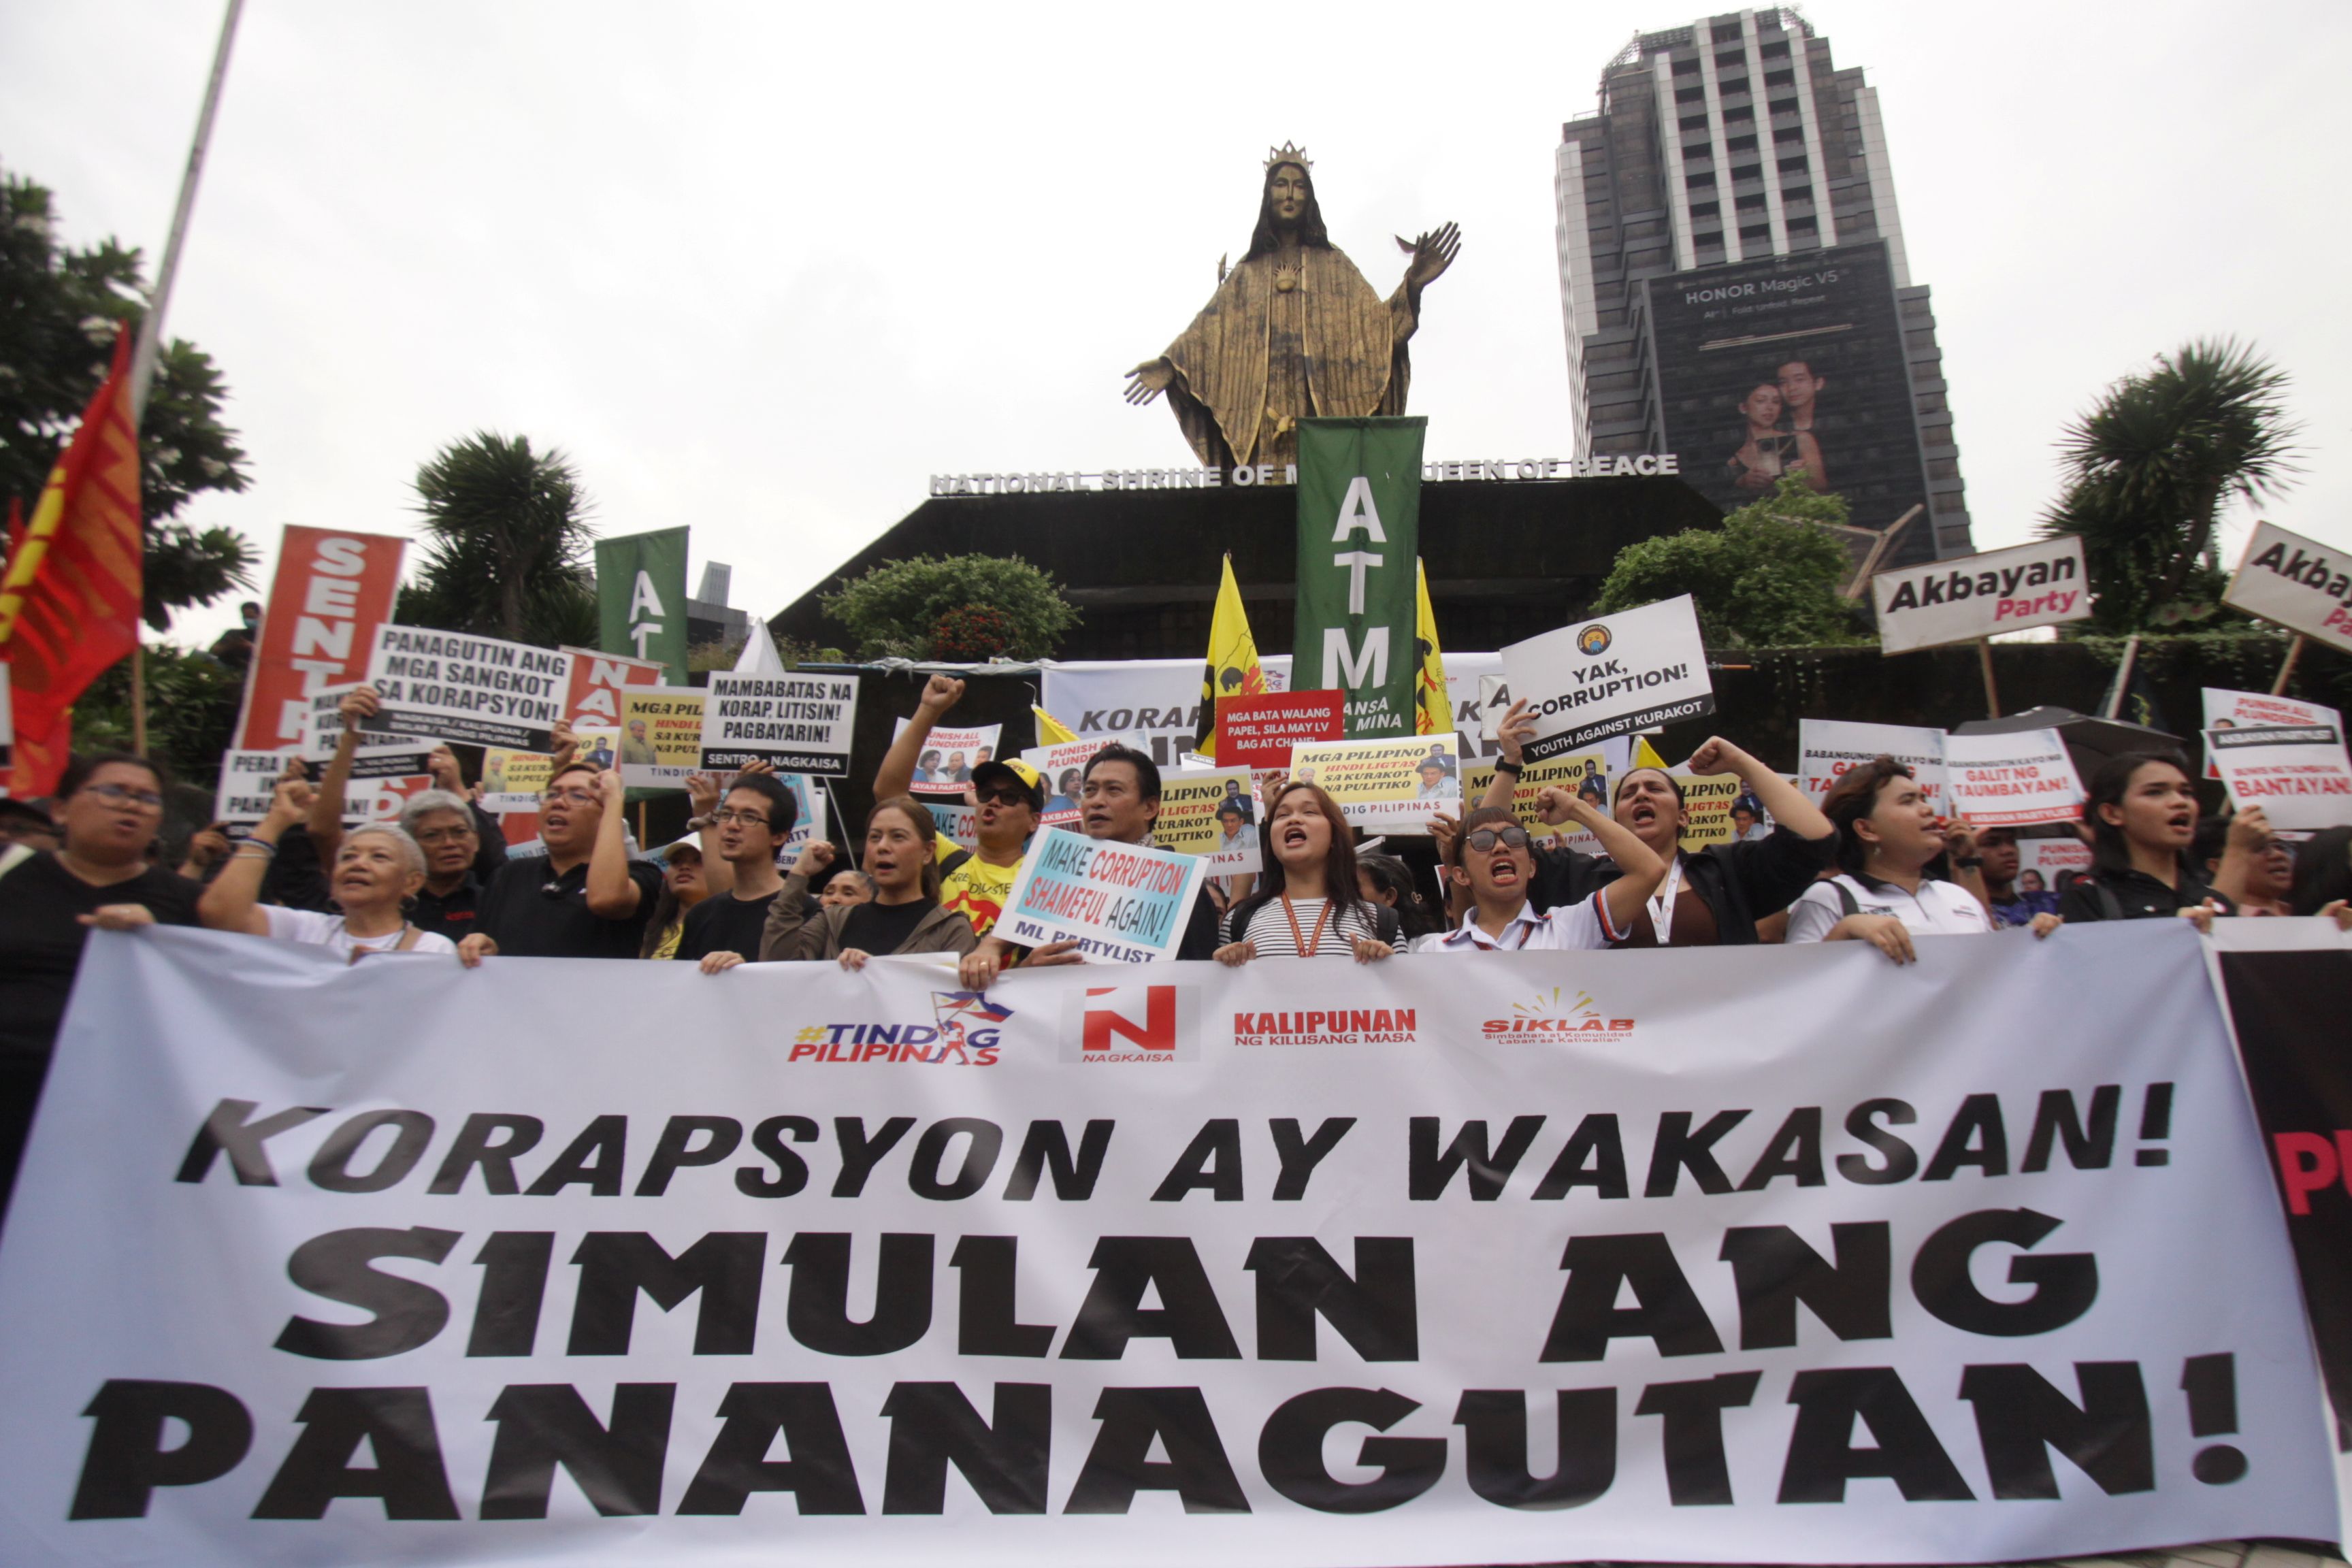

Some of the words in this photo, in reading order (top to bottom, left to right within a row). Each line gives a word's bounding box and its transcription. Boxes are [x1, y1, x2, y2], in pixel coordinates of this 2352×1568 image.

[1686, 283, 1755, 305] HONOR
[1761, 275, 1812, 293] Magic
[1815, 270, 1839, 284] V5
[930, 471, 1089, 496] NATIONAL
[1100, 466, 1222, 491] SHRINE
[1232, 464, 1273, 487] OF
[1517, 457, 1558, 480] OF
[1570, 453, 1680, 478] PEACE
[1886, 555, 2075, 614] Akbayan
[1994, 589, 2078, 621] Party
[382, 630, 515, 668] PANAGUTIN
[519, 651, 567, 677] ANG
[386, 655, 440, 681] MGA
[445, 662, 555, 699] SANGKOT
[1573, 659, 1628, 685] YAK,
[713, 679, 826, 700] MAMBABATAS
[829, 683, 852, 701] NA
[1527, 663, 1688, 720] CORRUPTION!
[374, 679, 403, 702] SA
[410, 683, 560, 723] KORAPSYON!
[630, 702, 672, 715] MGA
[2237, 698, 2289, 712] PUNISH
[719, 700, 772, 719] KORAP,
[776, 702, 841, 721] LITISIN!
[1227, 713, 1251, 723] MGA
[1252, 710, 1278, 721] BATA
[1281, 707, 1331, 719] WALANG
[459, 719, 523, 737] KALIPUNAN
[655, 719, 693, 730] HINDI
[723, 721, 831, 743] PAGBAYARIN!
[1228, 725, 1260, 737] PAPEL,
[1265, 724, 1286, 734] SILA
[1288, 722, 1313, 734] MAY
[1315, 722, 1330, 732] LV
[1356, 714, 1403, 733] MINA
[1531, 735, 1573, 757] YOUTH
[1575, 718, 1631, 744] AGAINST
[1635, 701, 1703, 726] KURAKOT
[439, 728, 476, 740] TINDIG
[478, 731, 530, 747] PILIPINAS
[653, 732, 672, 741] SA
[924, 739, 981, 748] UNDERERS
[928, 732, 962, 740] UNISH
[964, 732, 980, 740] ALL
[1237, 739, 1258, 750] BAG
[1260, 738, 1274, 749] AT
[653, 744, 671, 753] NA
[1050, 742, 1098, 759] PUNISH
[1301, 751, 1343, 764] MGA
[1345, 747, 1427, 762] PILIPINO
[708, 753, 759, 765] SENTRO
[771, 755, 841, 770] NAGKAISA
[1324, 762, 1365, 773] HINDI
[1367, 760, 1418, 770] LIGTAS
[1928, 757, 1943, 766] NG
[651, 767, 695, 777] TINDIG
[1323, 772, 1343, 783] SA
[1343, 769, 1414, 781] KURAKOT
[1966, 768, 2011, 782] GALIT
[2014, 766, 2039, 779] NG
[1323, 783, 1343, 793] NA
[1343, 780, 1412, 792] PULITIKO
[1955, 776, 2070, 797] TAUMBAYAN!
[1168, 803, 1216, 817] LIGTAS
[1343, 803, 1367, 815] DIG
[1370, 801, 1441, 814] PILIPINAS
[1686, 800, 1730, 812] LIGTAS
[932, 811, 956, 837] AKE
[1042, 810, 1082, 823] AKBAYA
[1042, 838, 1094, 877] MAKE
[1089, 849, 1188, 896] CORRUPTION
[1024, 876, 1109, 925] SHAMEFUL
[1105, 896, 1175, 943] AGAIN!
[1014, 920, 1045, 941] ML
[1051, 930, 1156, 964] PARTYLIST
[1233, 1008, 1416, 1036] KALIPUNAN
[1481, 1018, 1635, 1033] SIKLAB
[1235, 1034, 1263, 1046] NG
[1269, 1033, 1358, 1046] KILUSANG
[1364, 1032, 1416, 1044] MASA
[1484, 1031, 1545, 1040] Simbahan
[1082, 1053, 1174, 1063] NAGKAISA
[175, 1098, 1115, 1202] KORAPSYON
[1150, 1116, 1358, 1203] AY
[1408, 1081, 2174, 1202] WAKASAN!
[272, 1226, 1419, 1363] SIMULAN
[1539, 1206, 2100, 1363] ANG
[67, 1351, 2249, 1521] PANANAGUTAN!
